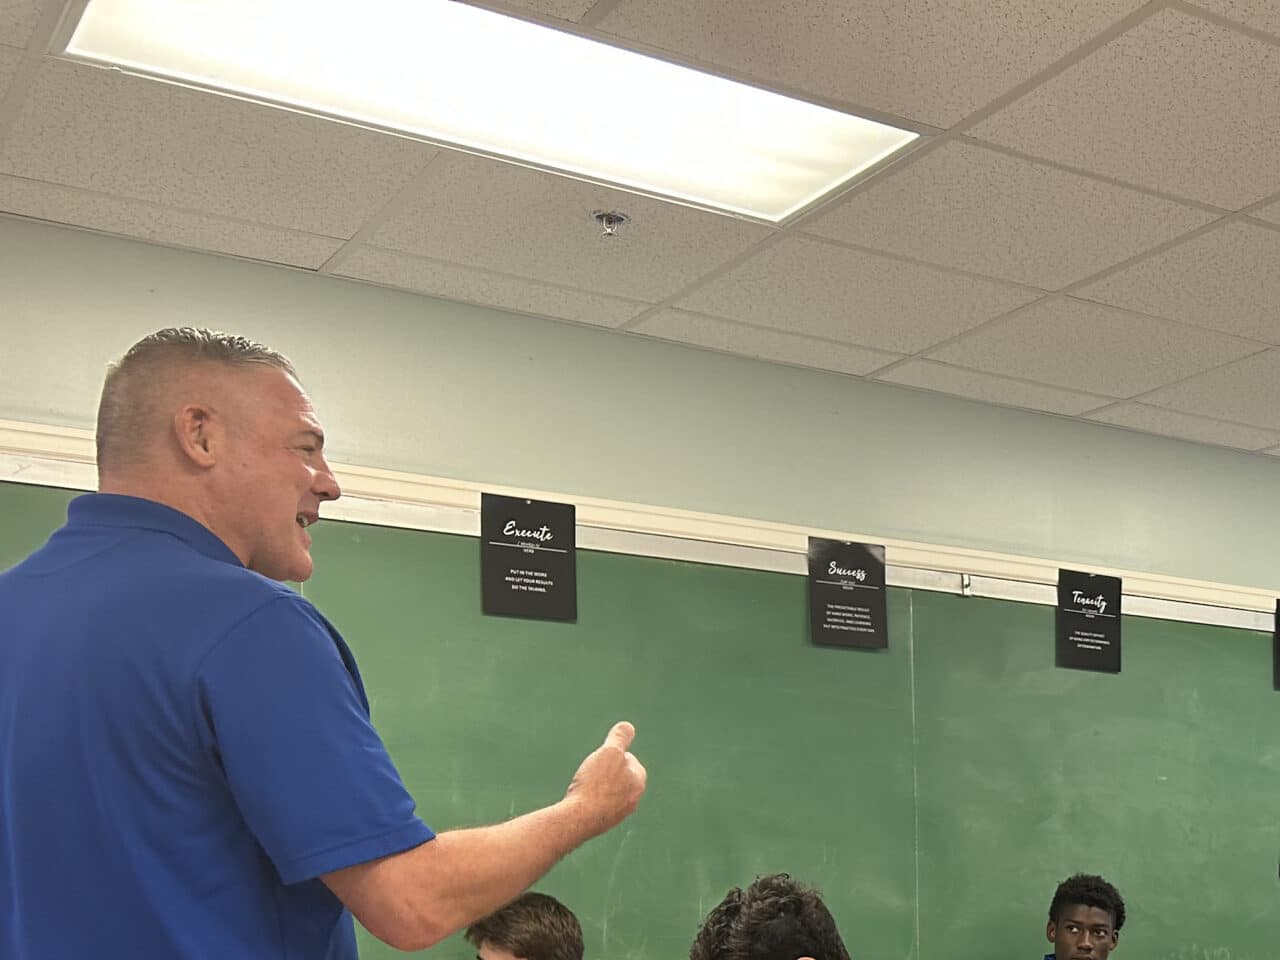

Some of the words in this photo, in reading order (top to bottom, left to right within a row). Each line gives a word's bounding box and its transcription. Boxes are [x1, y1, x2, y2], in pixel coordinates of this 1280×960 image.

[503, 520, 554, 542] Execute
[828, 561, 867, 581] Success
[1072, 590, 1107, 614] Tenacity
